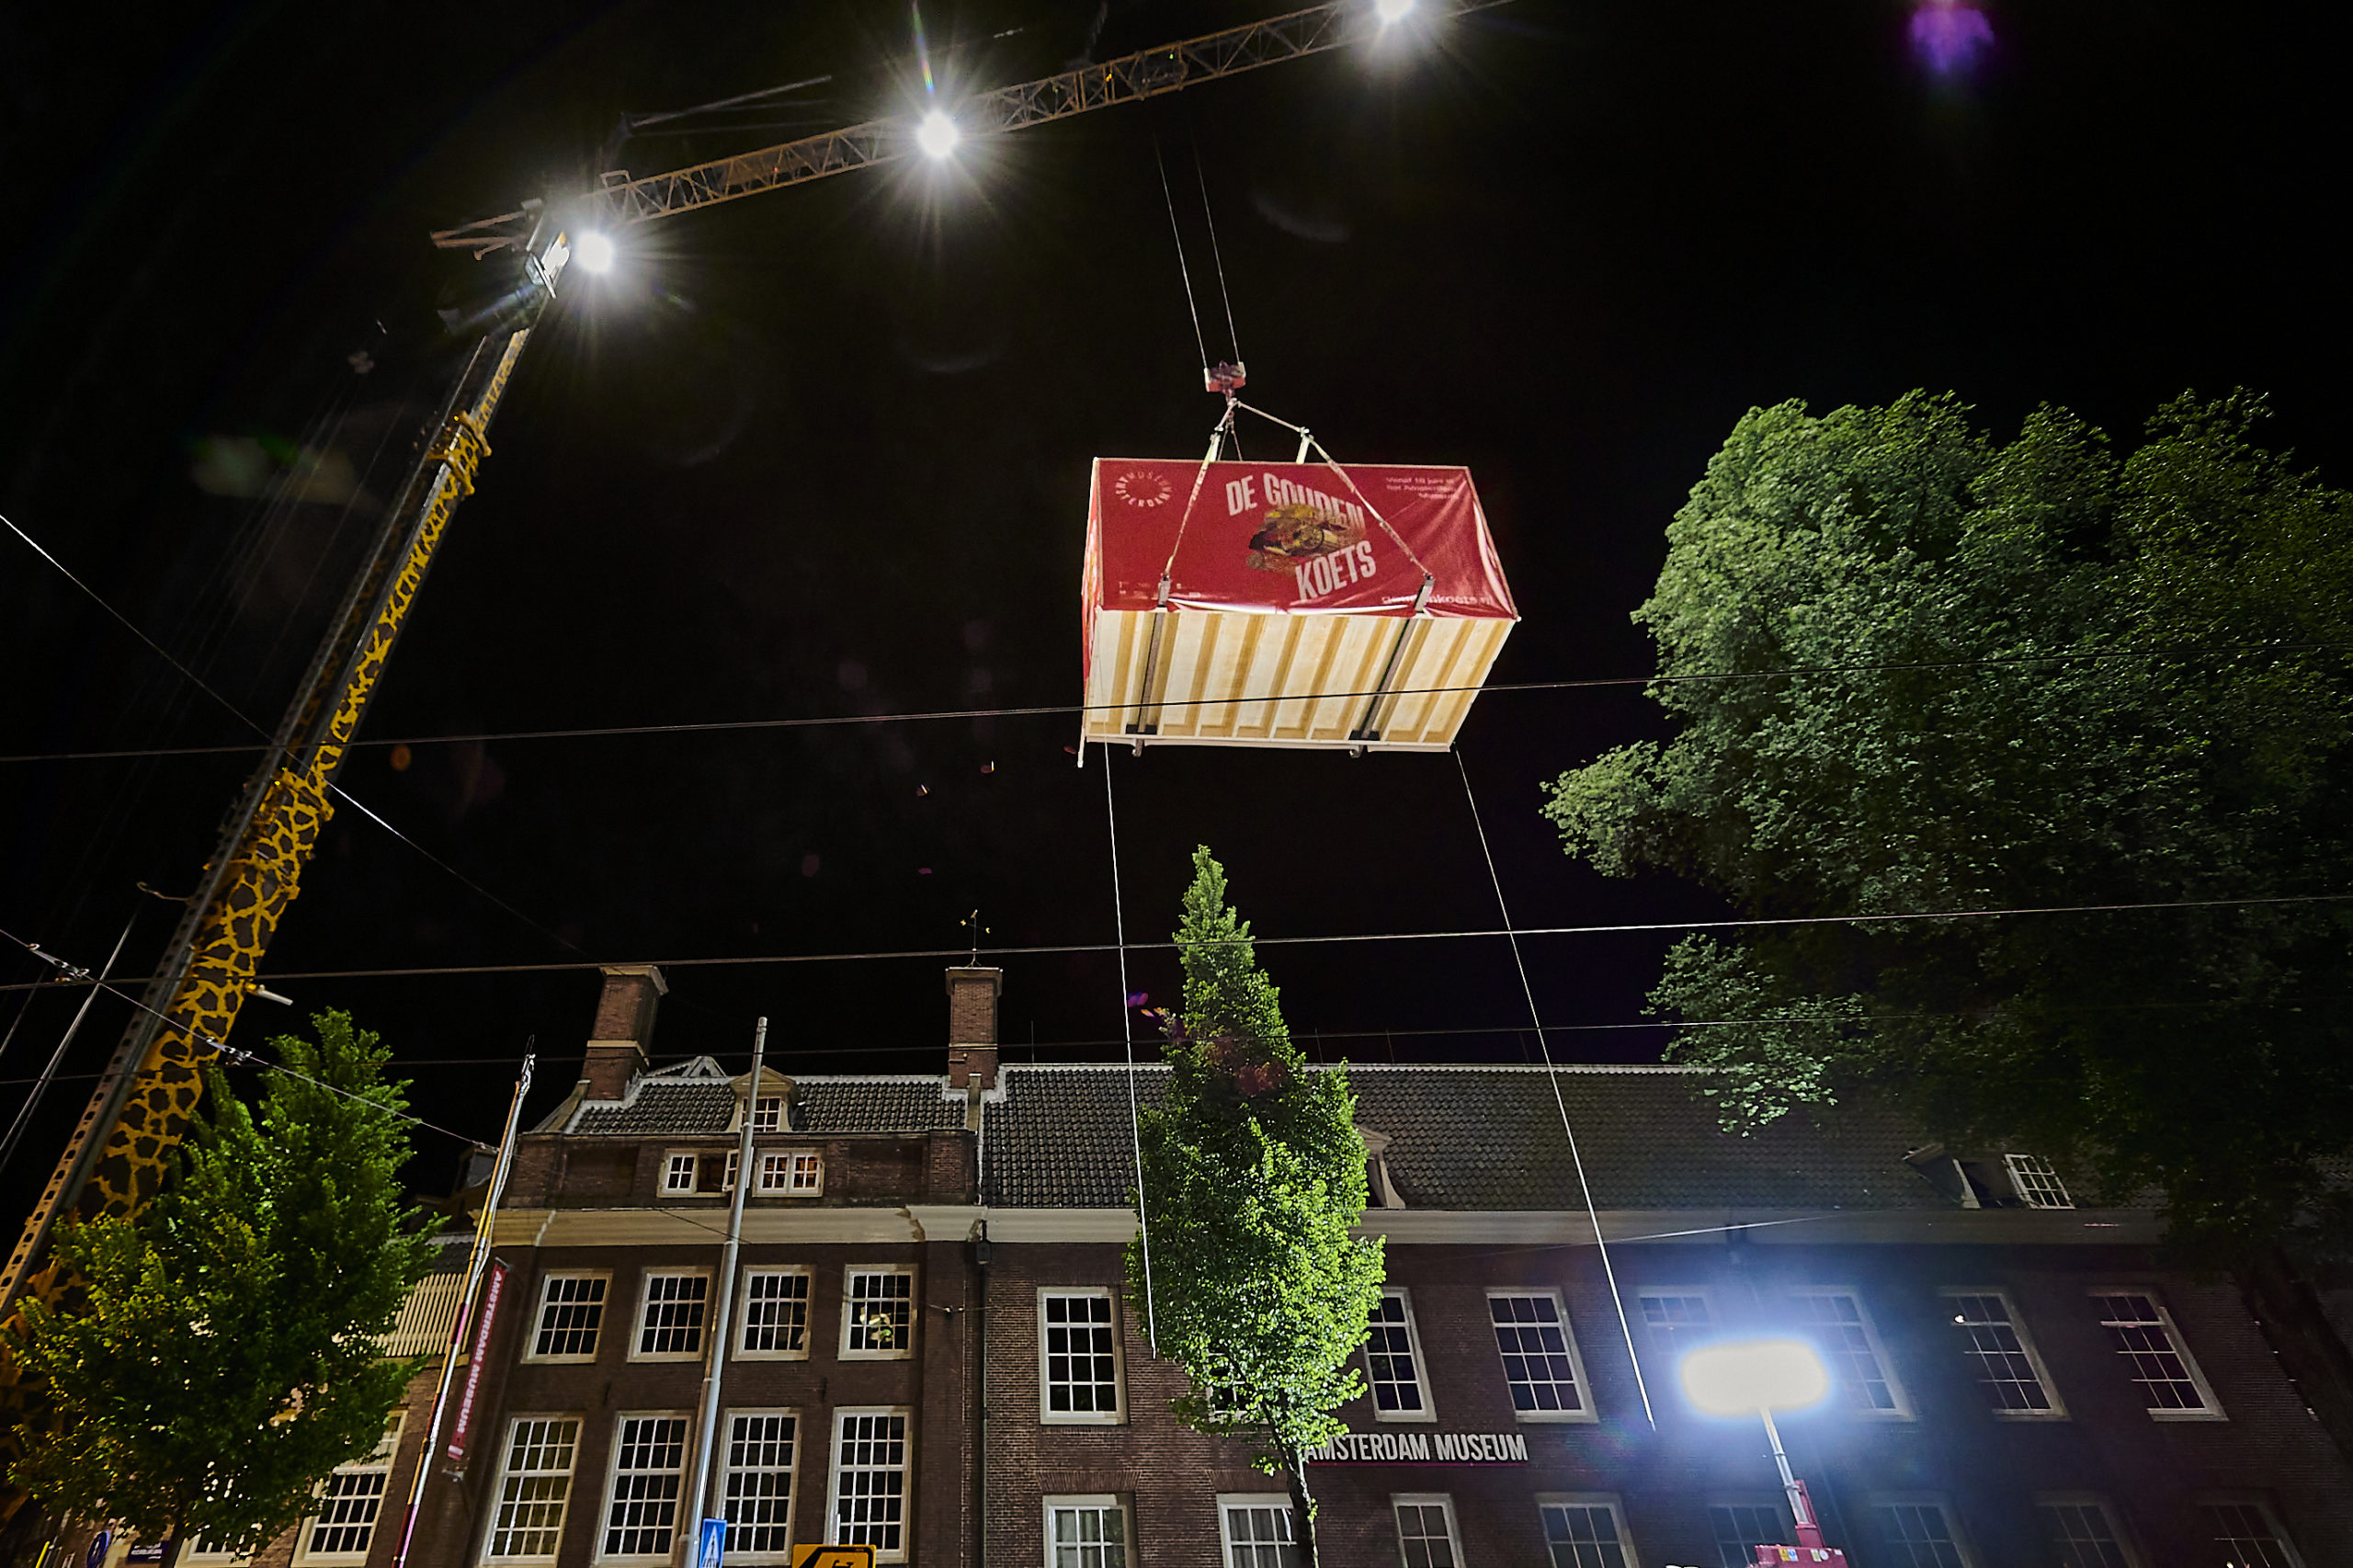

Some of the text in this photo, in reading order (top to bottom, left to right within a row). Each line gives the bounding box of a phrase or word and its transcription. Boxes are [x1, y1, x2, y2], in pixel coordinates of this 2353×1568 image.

[1225, 472, 1367, 535] DE GOUDEN
[1294, 540, 1377, 604] KOETS
[457, 1270, 502, 1434] AMSTERDAM MUSEUM
[1303, 1434, 1529, 1460] AMSTERDAM MUSEUM
